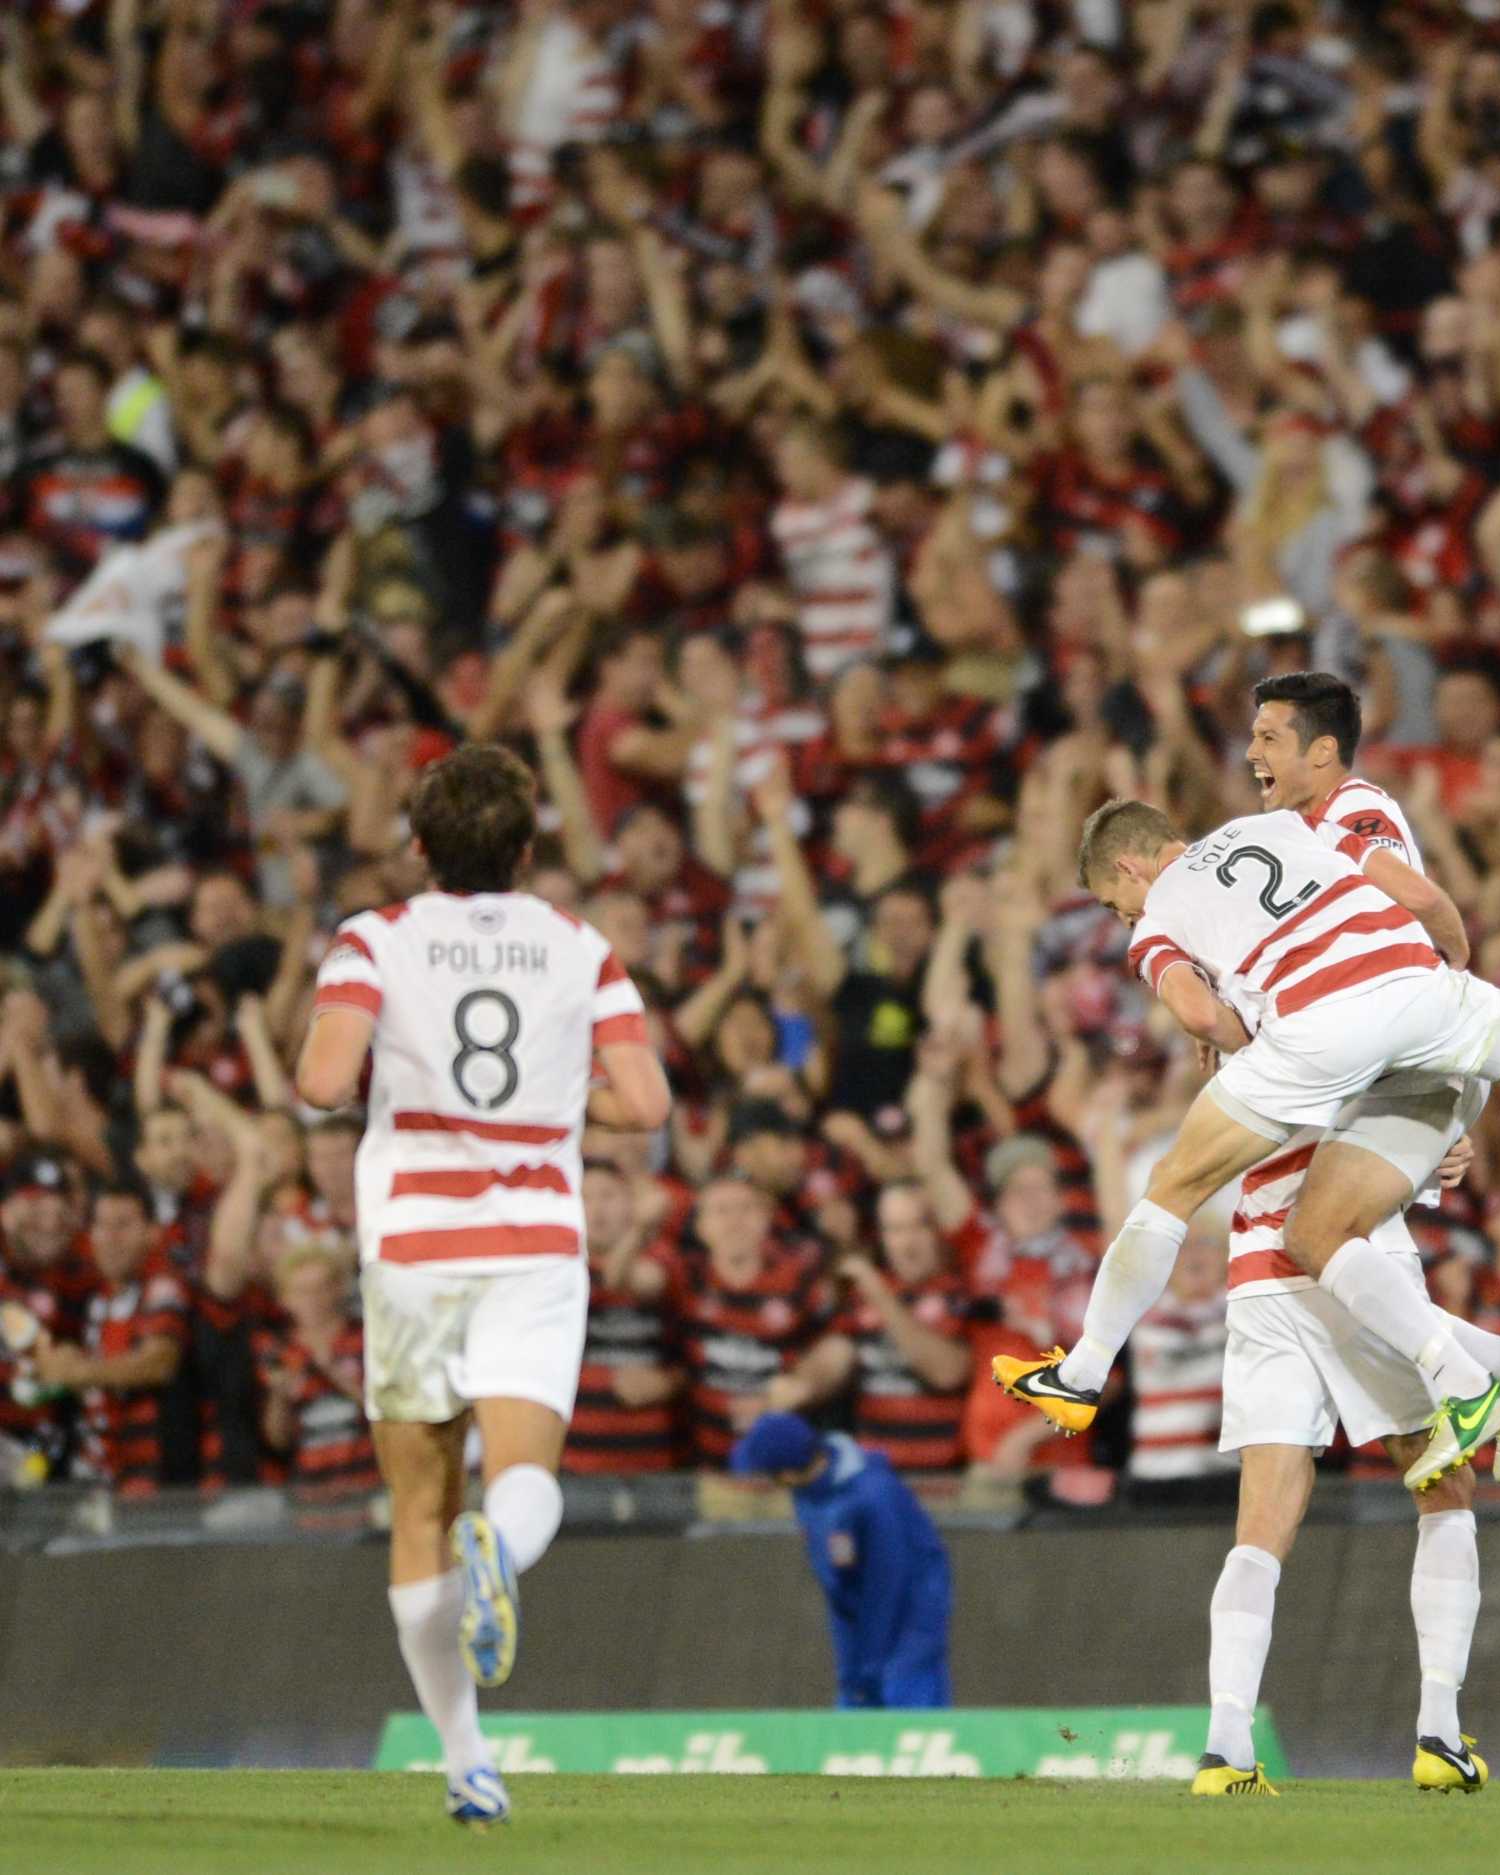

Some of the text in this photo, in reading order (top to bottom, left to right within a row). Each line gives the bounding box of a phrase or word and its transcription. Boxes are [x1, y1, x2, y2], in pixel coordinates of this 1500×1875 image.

[1187, 828, 1242, 872] COLE
[1216, 845, 1322, 921] 2
[427, 939, 549, 974] POLJAK
[452, 989, 520, 1109] 8
